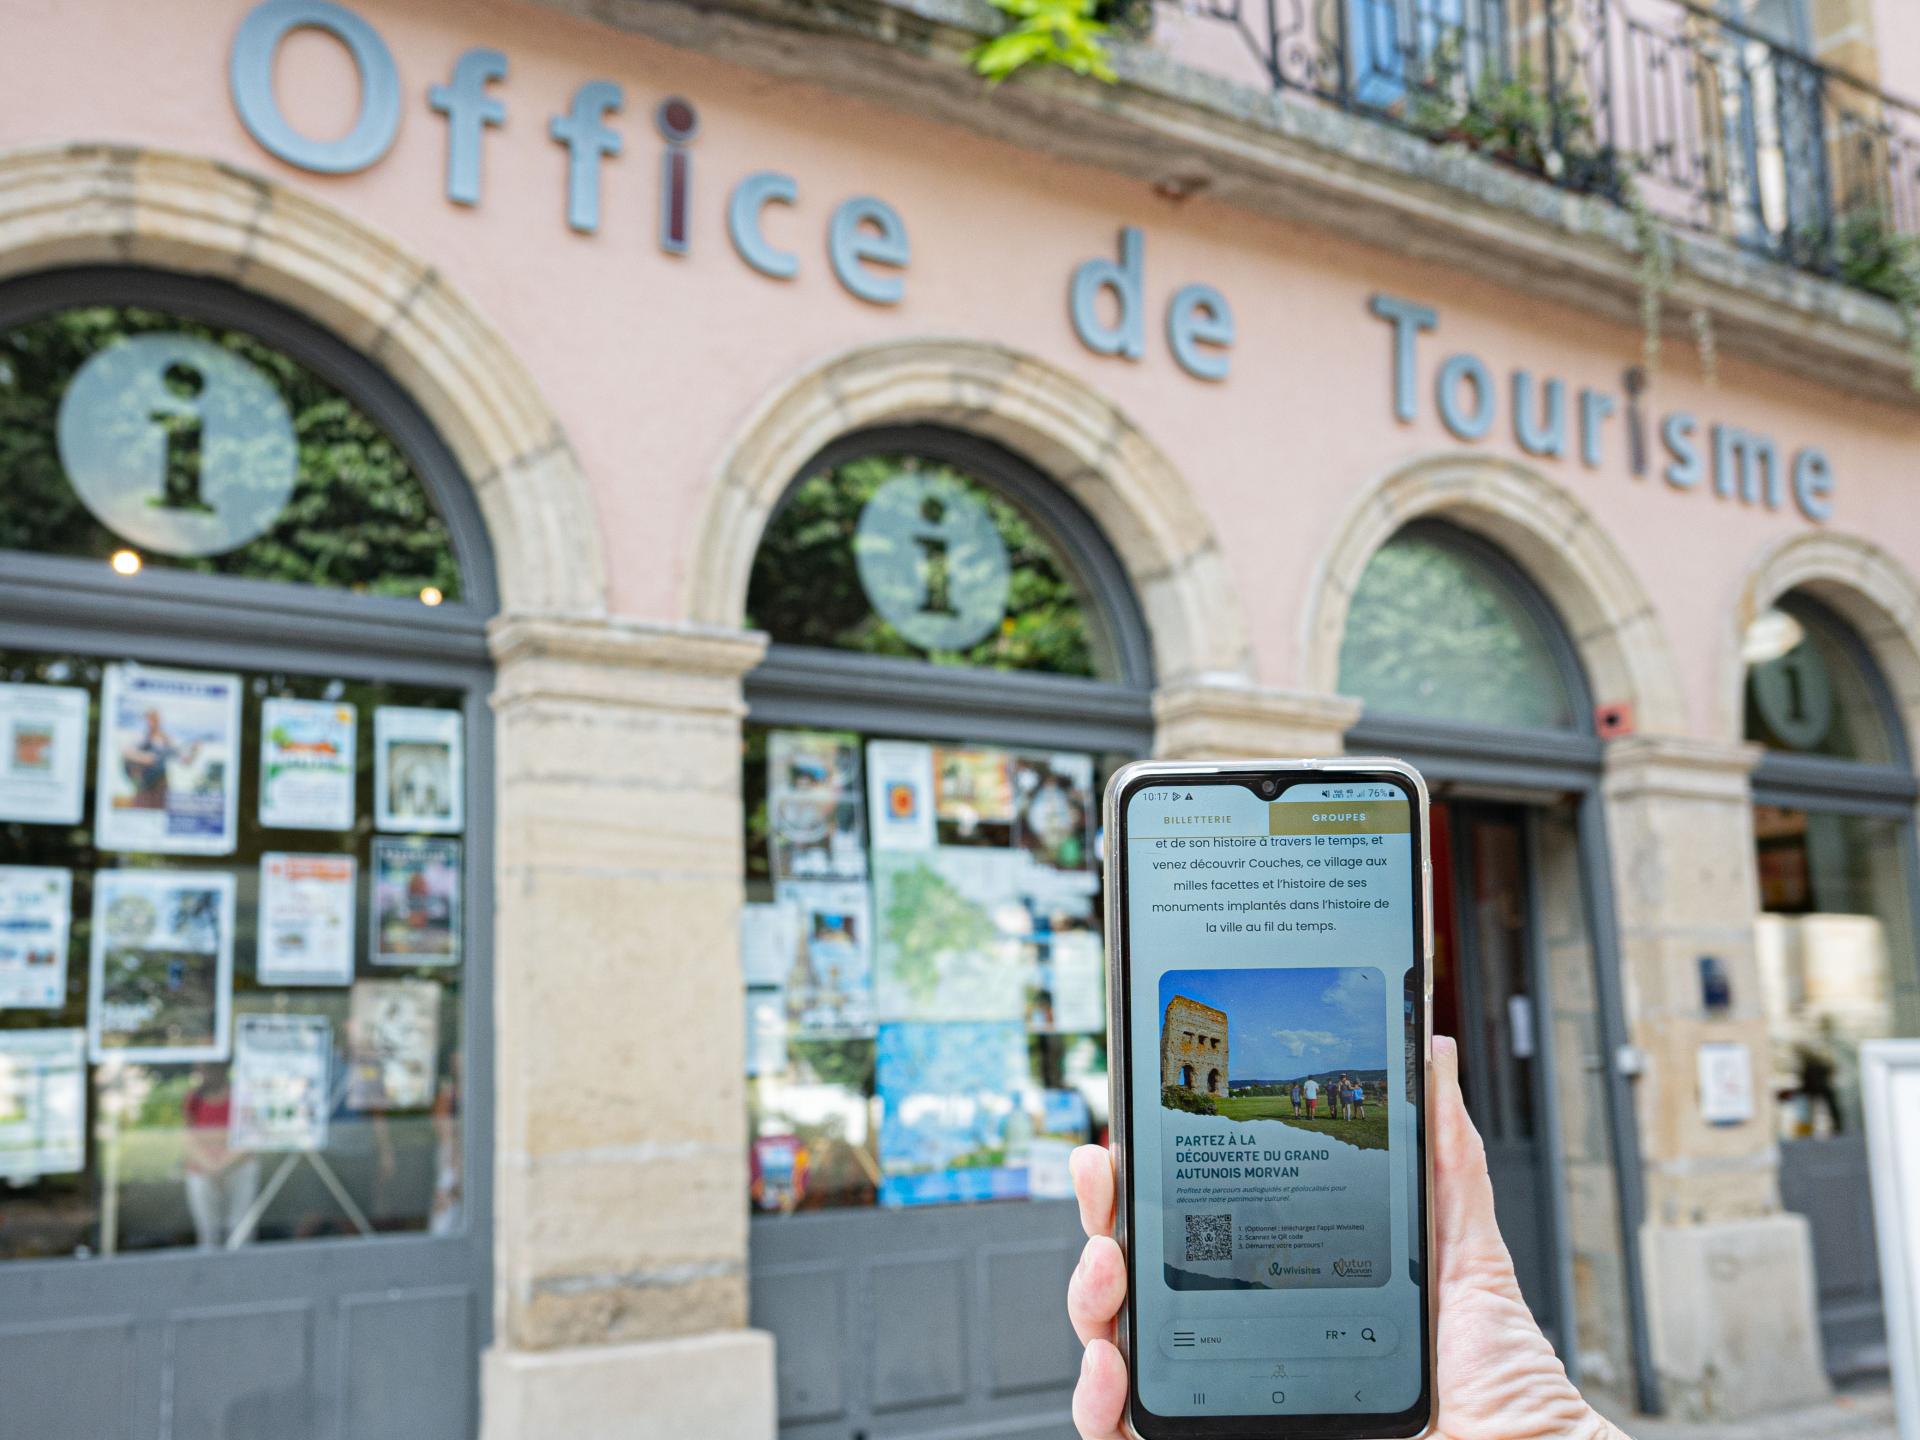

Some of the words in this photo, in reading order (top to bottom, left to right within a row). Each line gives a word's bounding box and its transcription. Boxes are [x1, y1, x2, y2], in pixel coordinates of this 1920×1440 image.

[229, 0, 911, 306] Office
[1067, 225, 1237, 382] de
[1367, 292, 1836, 522] Tourisme
[1142, 792, 1168, 801] 10:17
[1368, 788, 1388, 798] 76%
[1163, 815, 1232, 824] BILLETTERIE
[1312, 813, 1367, 822] GROUPES
[1155, 839, 1168, 848] et
[1170, 837, 1186, 848] de
[1189, 839, 1210, 848] son
[1213, 836, 1257, 847] histoire
[1259, 836, 1268, 847] à
[1270, 837, 1312, 846] travers
[1314, 836, 1325, 846] le
[1328, 836, 1369, 848] temps,
[1371, 835, 1384, 845] et
[1152, 860, 1187, 870] venez
[1189, 858, 1246, 869] découvrir
[1248, 857, 1304, 868] Couches,
[1306, 859, 1321, 867] ce
[1324, 856, 1363, 870] village
[1365, 858, 1388, 867] aux
[1173, 880, 1208, 891] milles
[1211, 879, 1260, 890] facettes
[1262, 879, 1274, 889] et
[1328, 878, 1344, 888] de
[1347, 879, 1367, 888] ses
[1152, 902, 1224, 912] monuments
[1227, 900, 1286, 913] implantés
[1289, 900, 1319, 910] dans
[1374, 898, 1390, 908] de
[1206, 922, 1217, 932] la
[1220, 922, 1242, 932] ville
[1246, 924, 1261, 932] au
[1264, 921, 1274, 932] fil
[1277, 921, 1293, 931] du
[1296, 921, 1337, 934] temps.
[1175, 1135, 1225, 1146] PARTEZ
[1228, 1131, 1237, 1146] À
[1240, 1134, 1257, 1146] LA
[1176, 1148, 1260, 1163] DÉCOUVERTE
[1263, 1150, 1281, 1161] DU
[1284, 1149, 1330, 1161] GRAND
[1176, 1168, 1241, 1180] AUTUNOIS
[1244, 1166, 1299, 1178] MORVAN
[1212, 1186, 1241, 1195] parcours
[1330, 1184, 1347, 1193] pour
[1176, 1196, 1207, 1204] découvrir
[1325, 1330, 1338, 1340] FR
